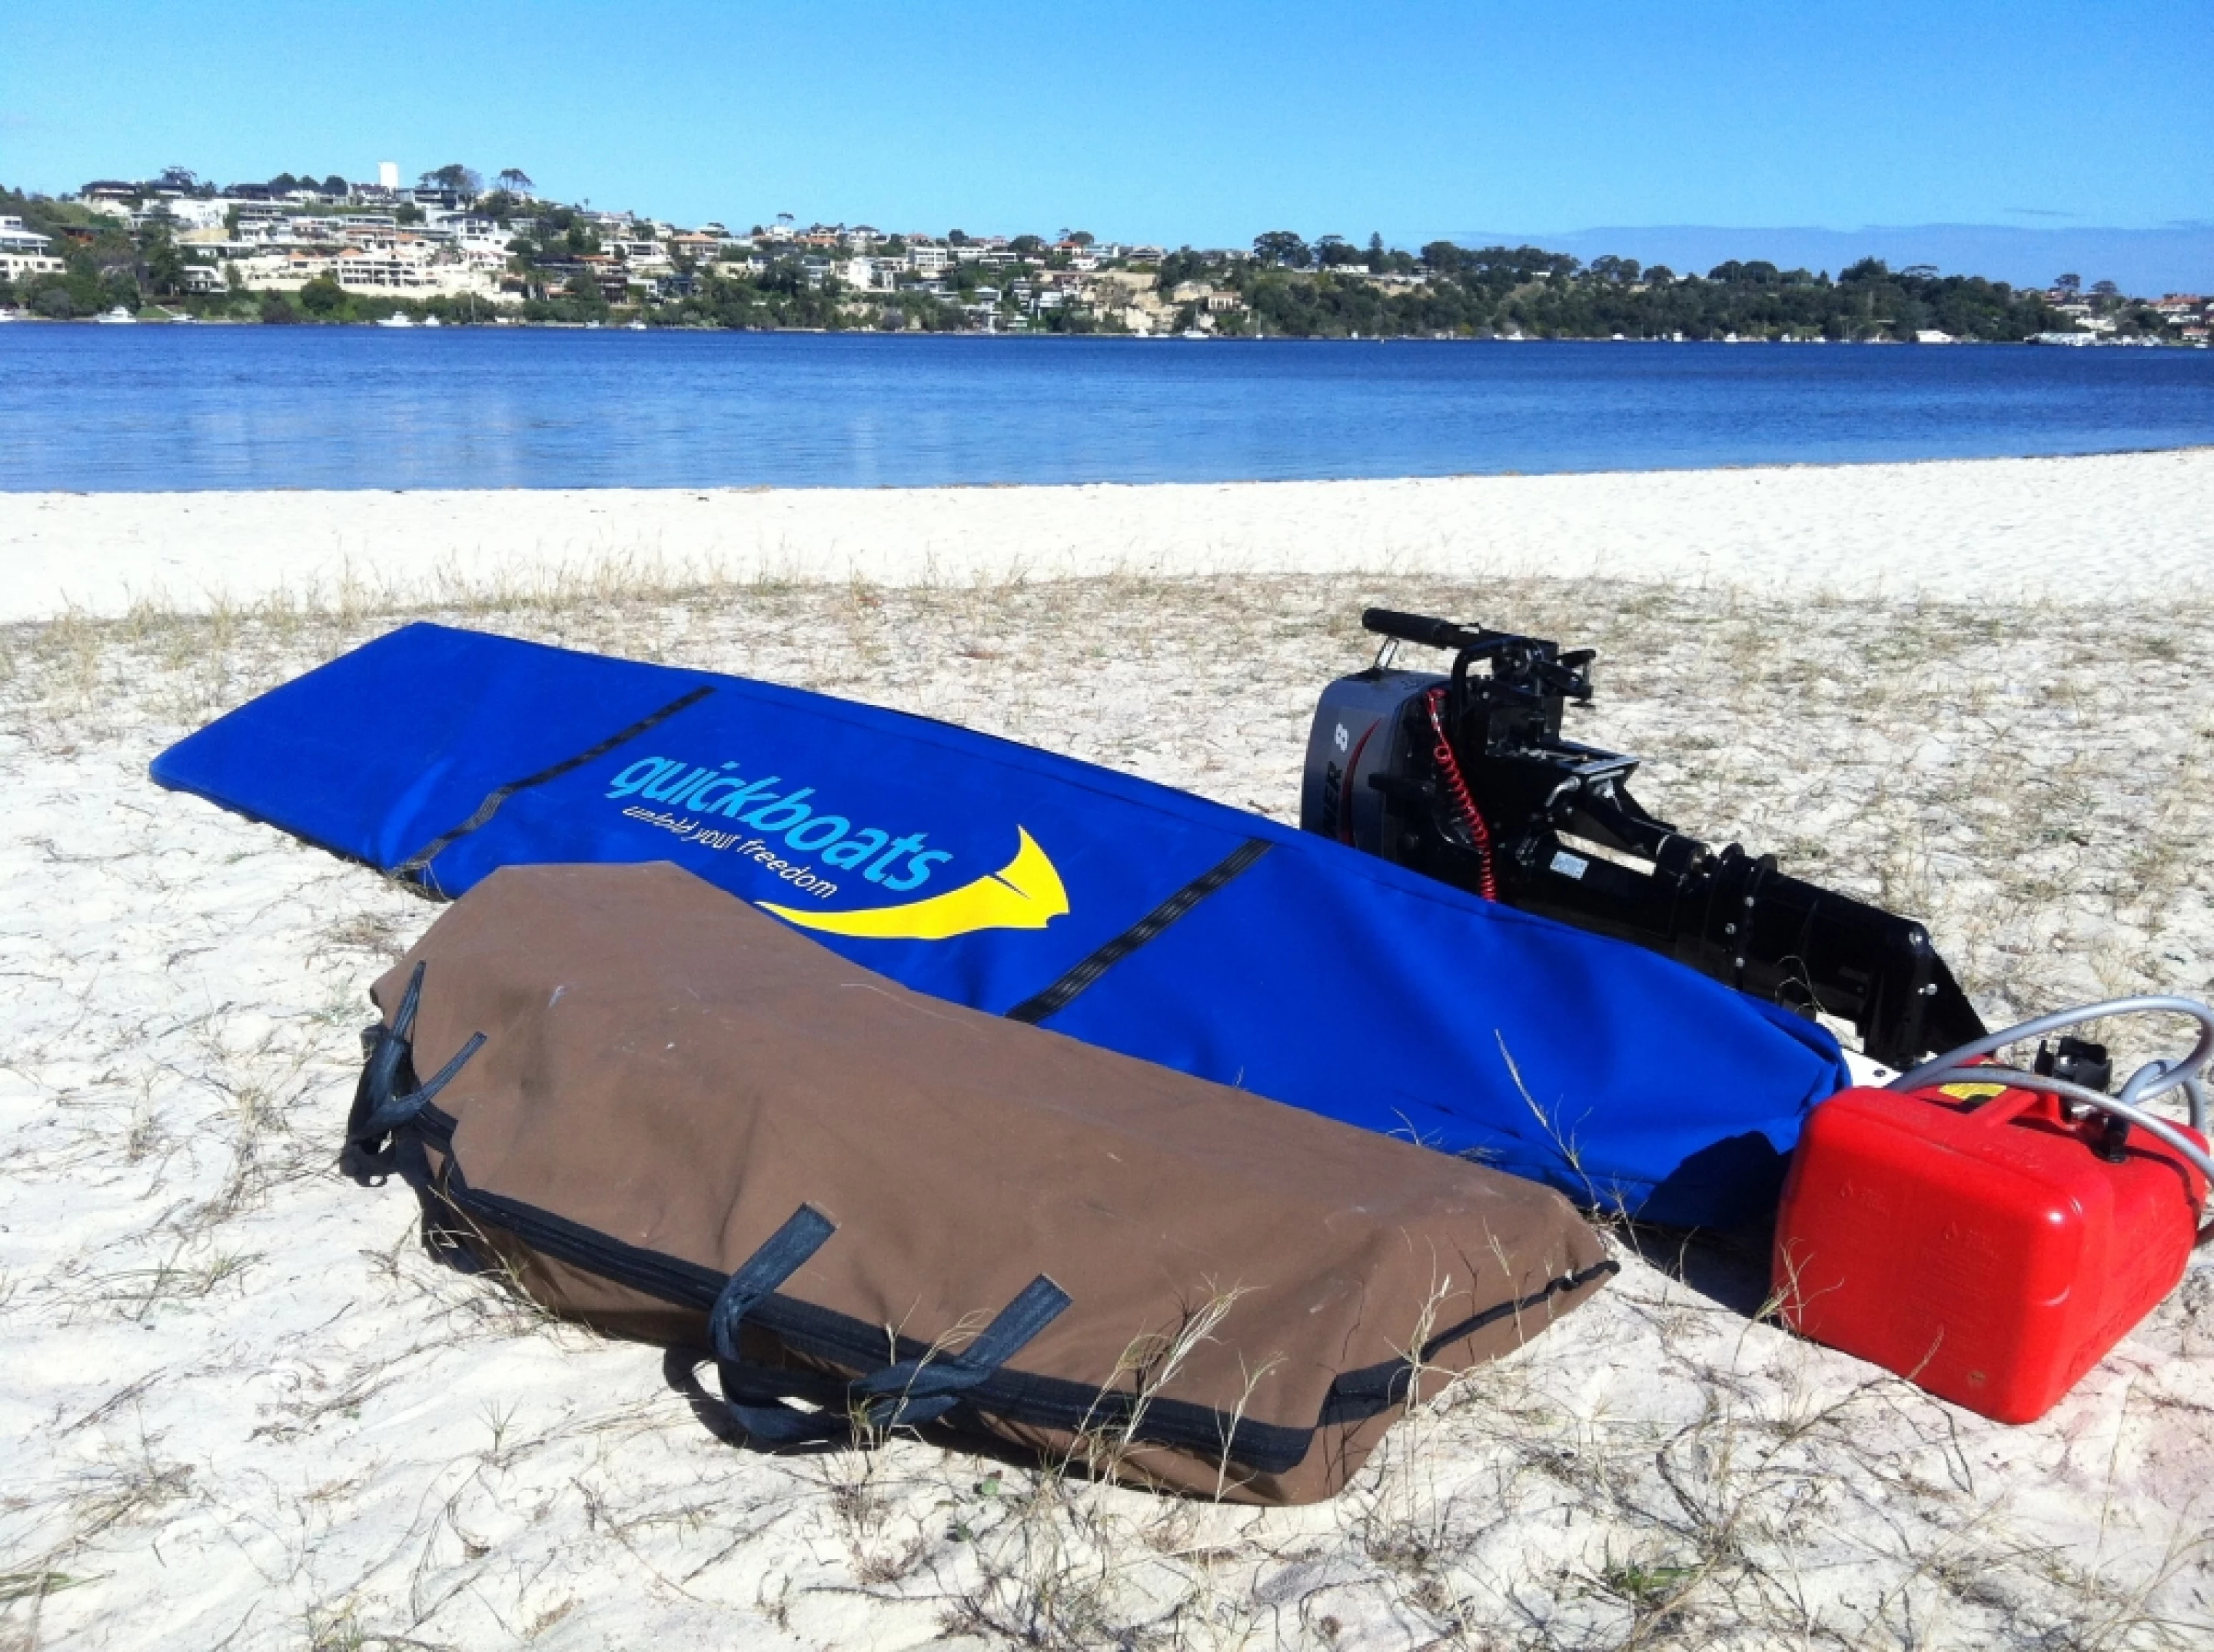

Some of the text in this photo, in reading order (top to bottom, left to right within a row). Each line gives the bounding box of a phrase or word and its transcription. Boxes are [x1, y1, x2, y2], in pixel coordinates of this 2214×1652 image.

[605, 756, 952, 891] quickboats
[622, 806, 838, 899] unfold your freedom
